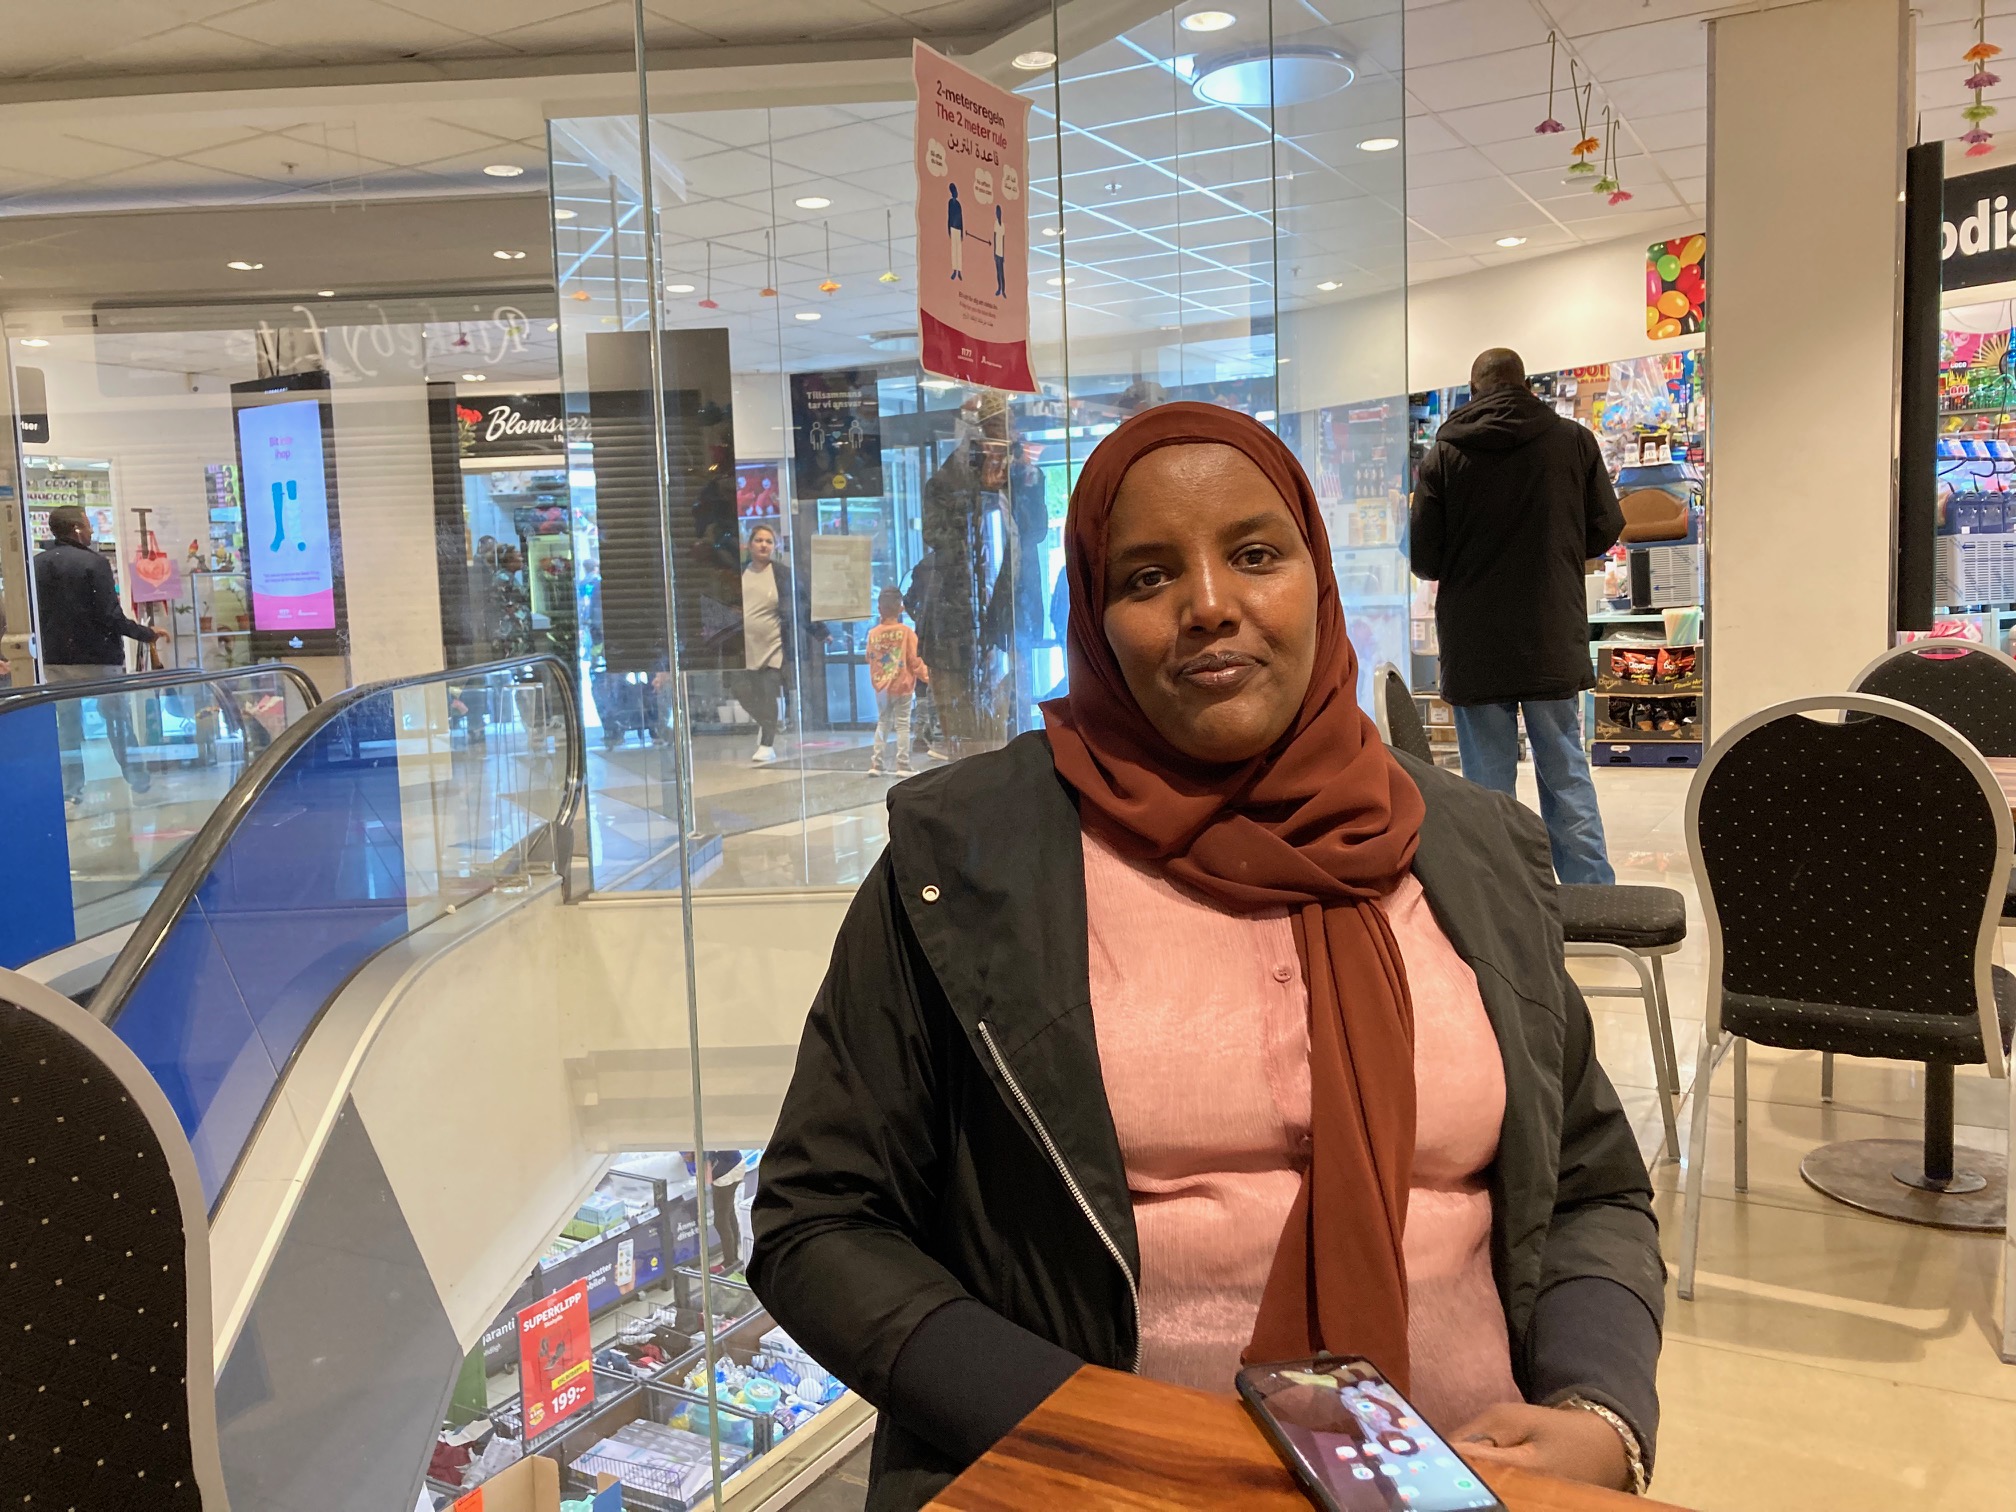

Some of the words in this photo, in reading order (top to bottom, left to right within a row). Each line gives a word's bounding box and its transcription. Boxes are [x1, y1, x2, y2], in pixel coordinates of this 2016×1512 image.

[936, 79, 1006, 128] 2-metersregeln
[935, 101, 955, 122] The
[956, 112, 963, 127] 2
[964, 117, 990, 140] meter
[992, 130, 1008, 150] rule
[806, 390, 862, 400] Tillsammans
[808, 401, 821, 410] tar
[822, 400, 831, 408] vi
[833, 400, 862, 410] ansvar
[523, 1292, 582, 1332] SUPERKLIPP
